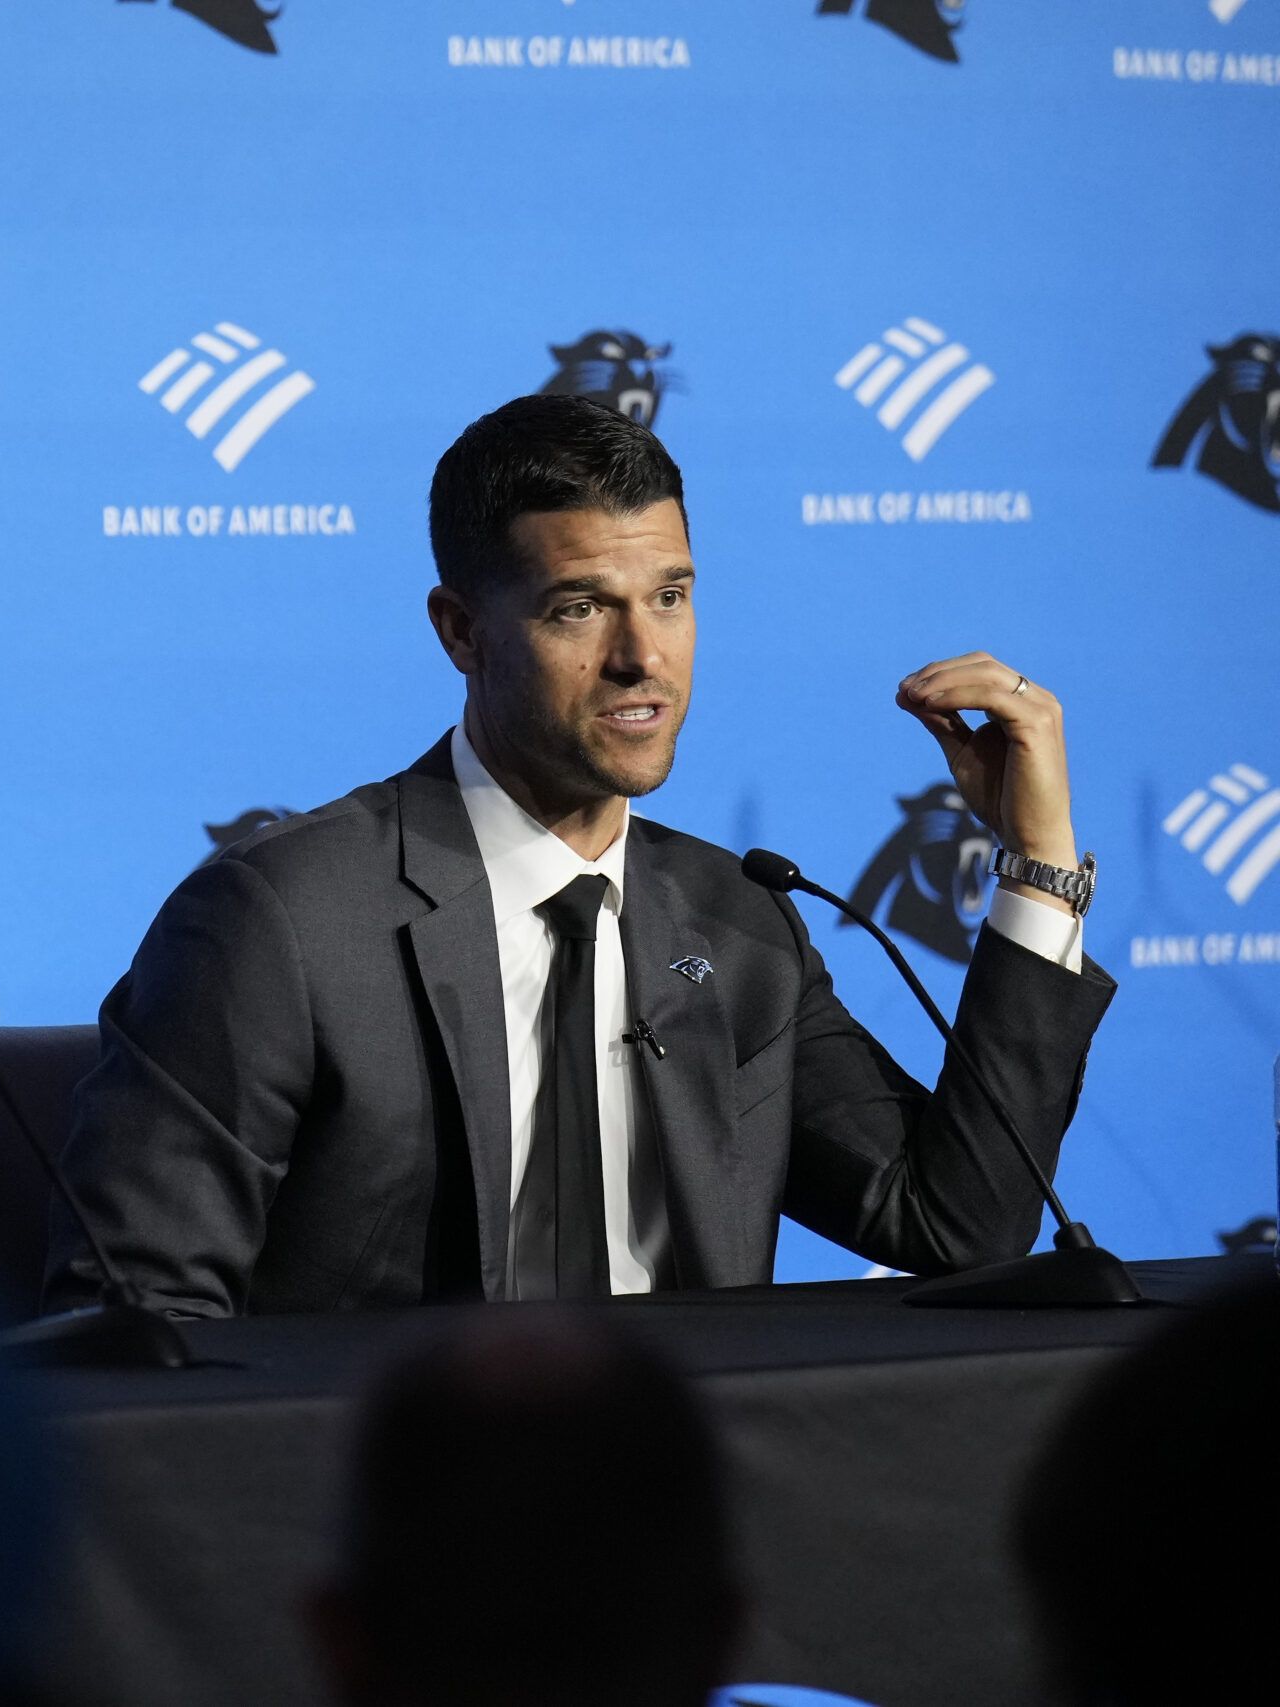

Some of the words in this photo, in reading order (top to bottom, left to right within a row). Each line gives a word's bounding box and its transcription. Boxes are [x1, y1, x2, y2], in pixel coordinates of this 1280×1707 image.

[447, 35, 524, 67] BANK
[527, 36, 563, 68] OF
[567, 36, 690, 69] AMERICA
[1113, 47, 1183, 81] BANK
[1185, 50, 1219, 83] OF
[102, 504, 182, 537] BANK
[186, 504, 224, 537] OF
[228, 503, 356, 537] AMERICA
[801, 493, 875, 525] BANK
[877, 491, 913, 525] OF
[915, 490, 1032, 523] AMERICA
[1130, 935, 1200, 969] BANK
[1202, 932, 1236, 966] OF
